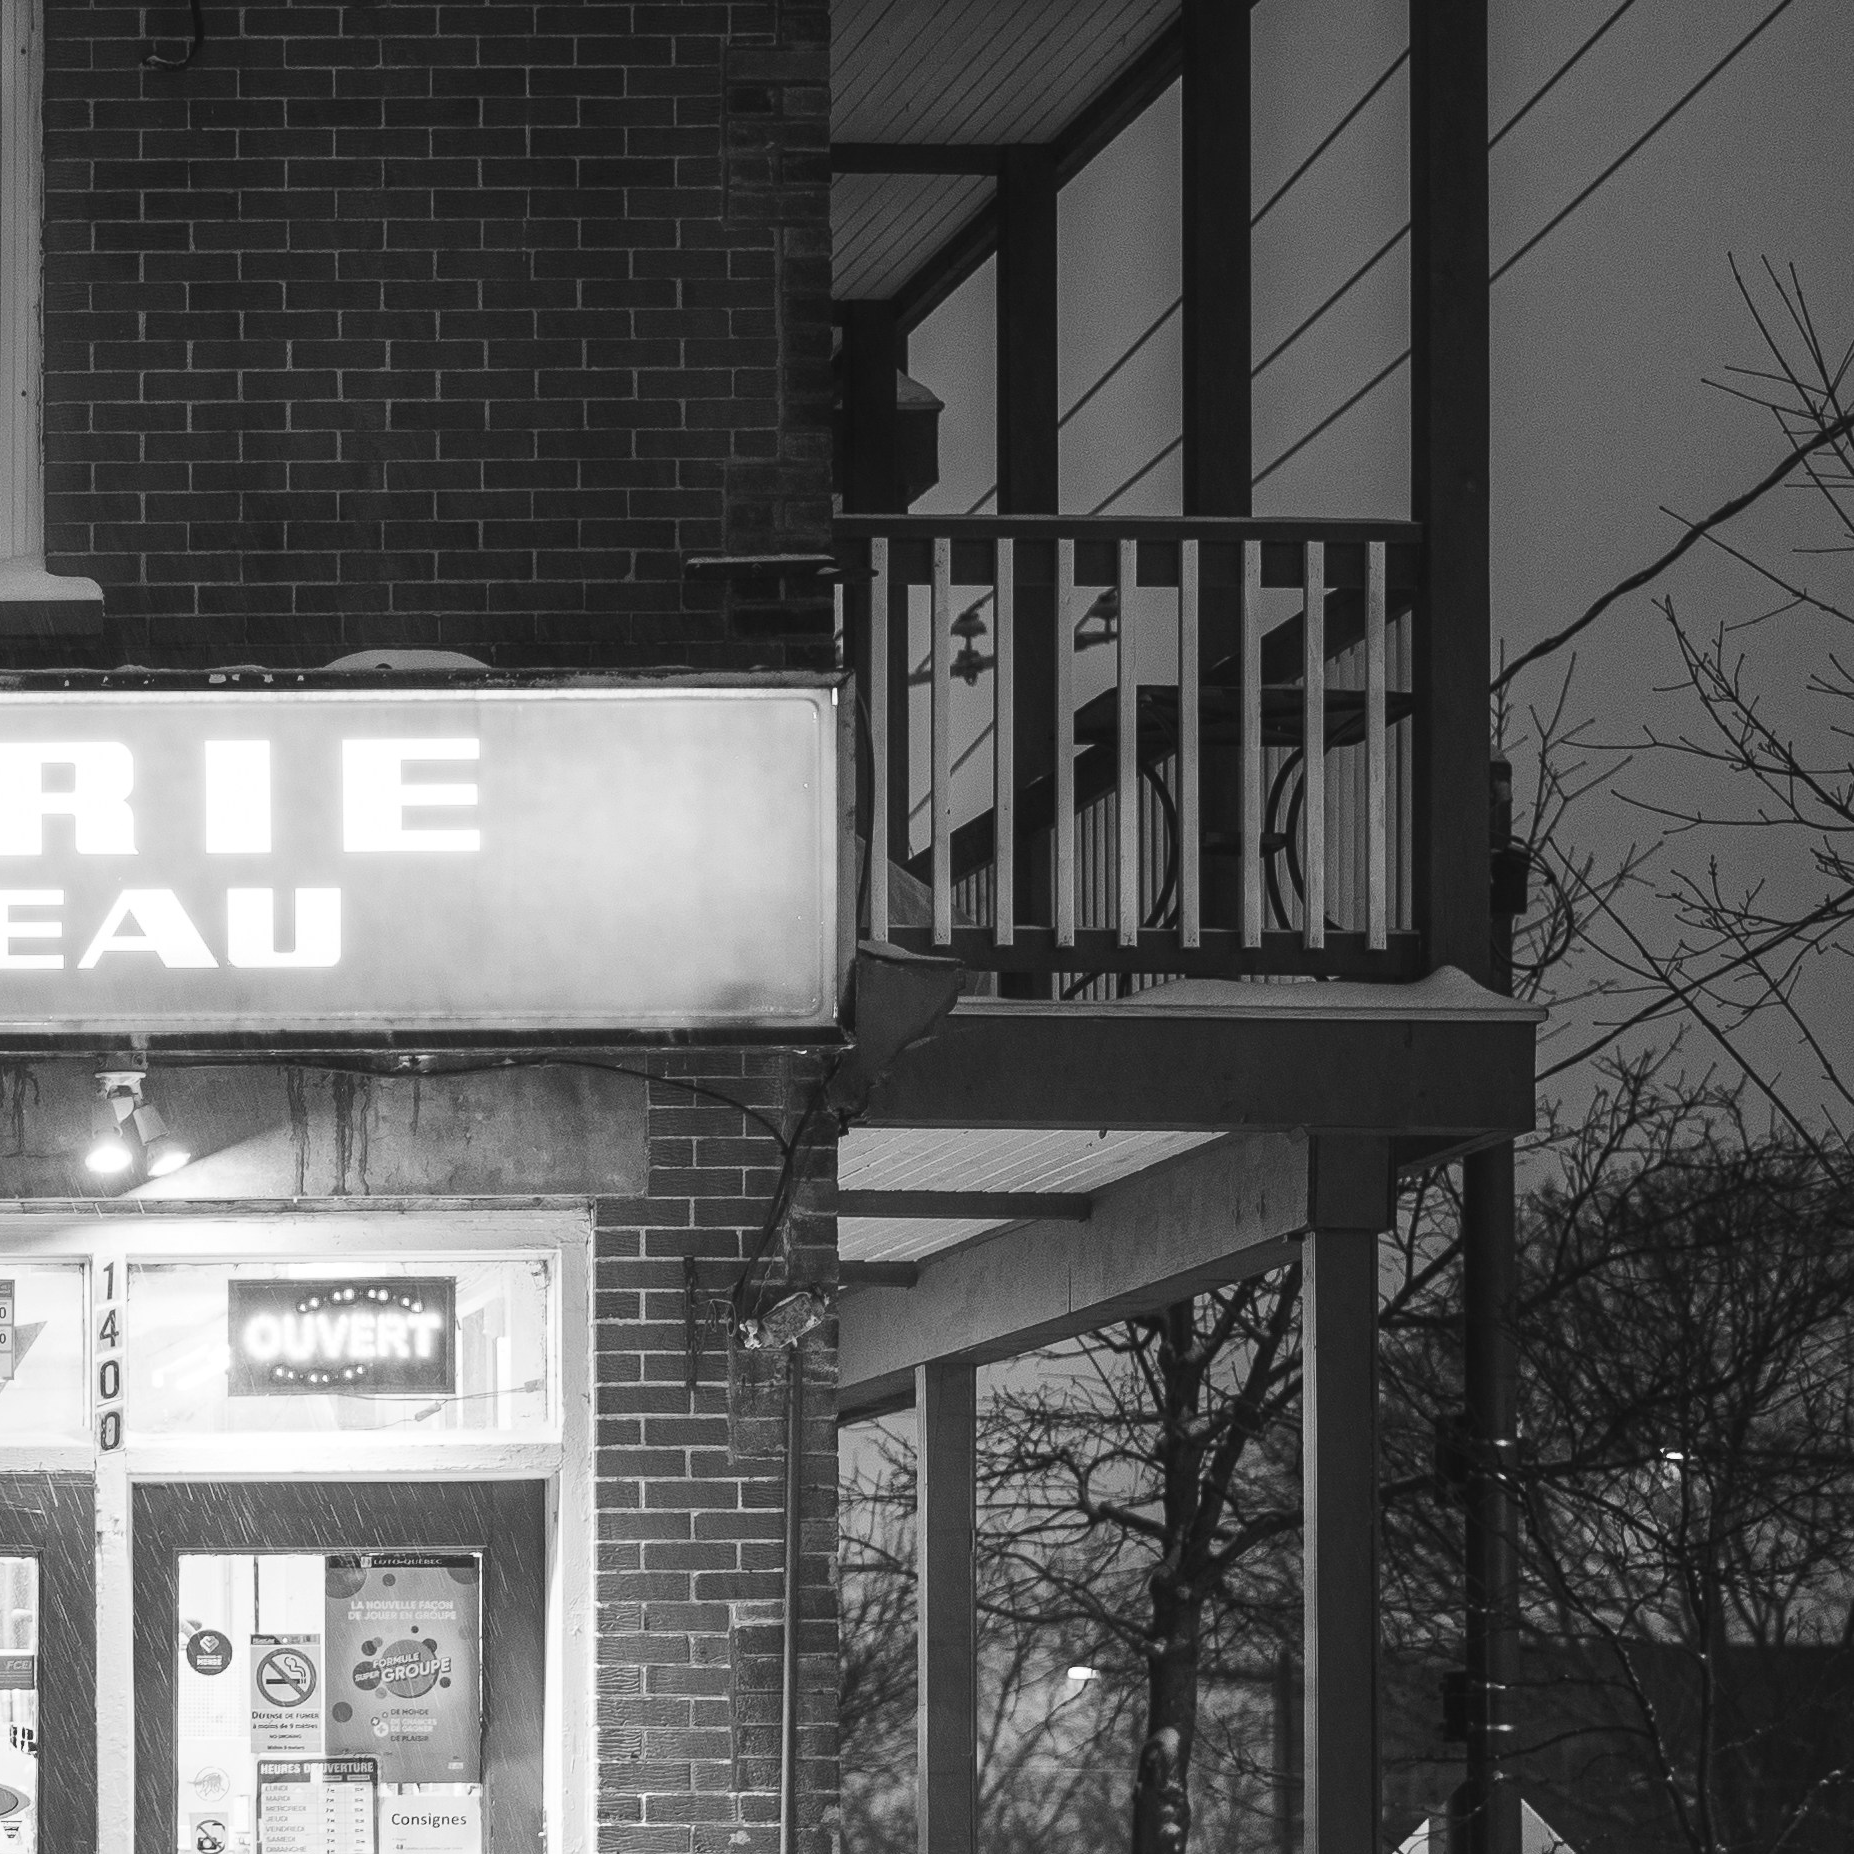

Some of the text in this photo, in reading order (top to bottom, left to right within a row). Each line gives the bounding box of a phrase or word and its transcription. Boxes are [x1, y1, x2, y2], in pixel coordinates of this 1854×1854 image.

[242, 1310, 444, 1363] OUVERT
[350, 1600, 454, 1612] LA NOUVELLE FAÇON
[347, 1611, 457, 1620] DE JOUER EN GROUPE
[372, 1651, 421, 1669] FORMULE
[354, 1656, 452, 1684] SUPER GROUPE
[260, 1763, 301, 1774] HEURES
[391, 1812, 467, 1828] Consignes
